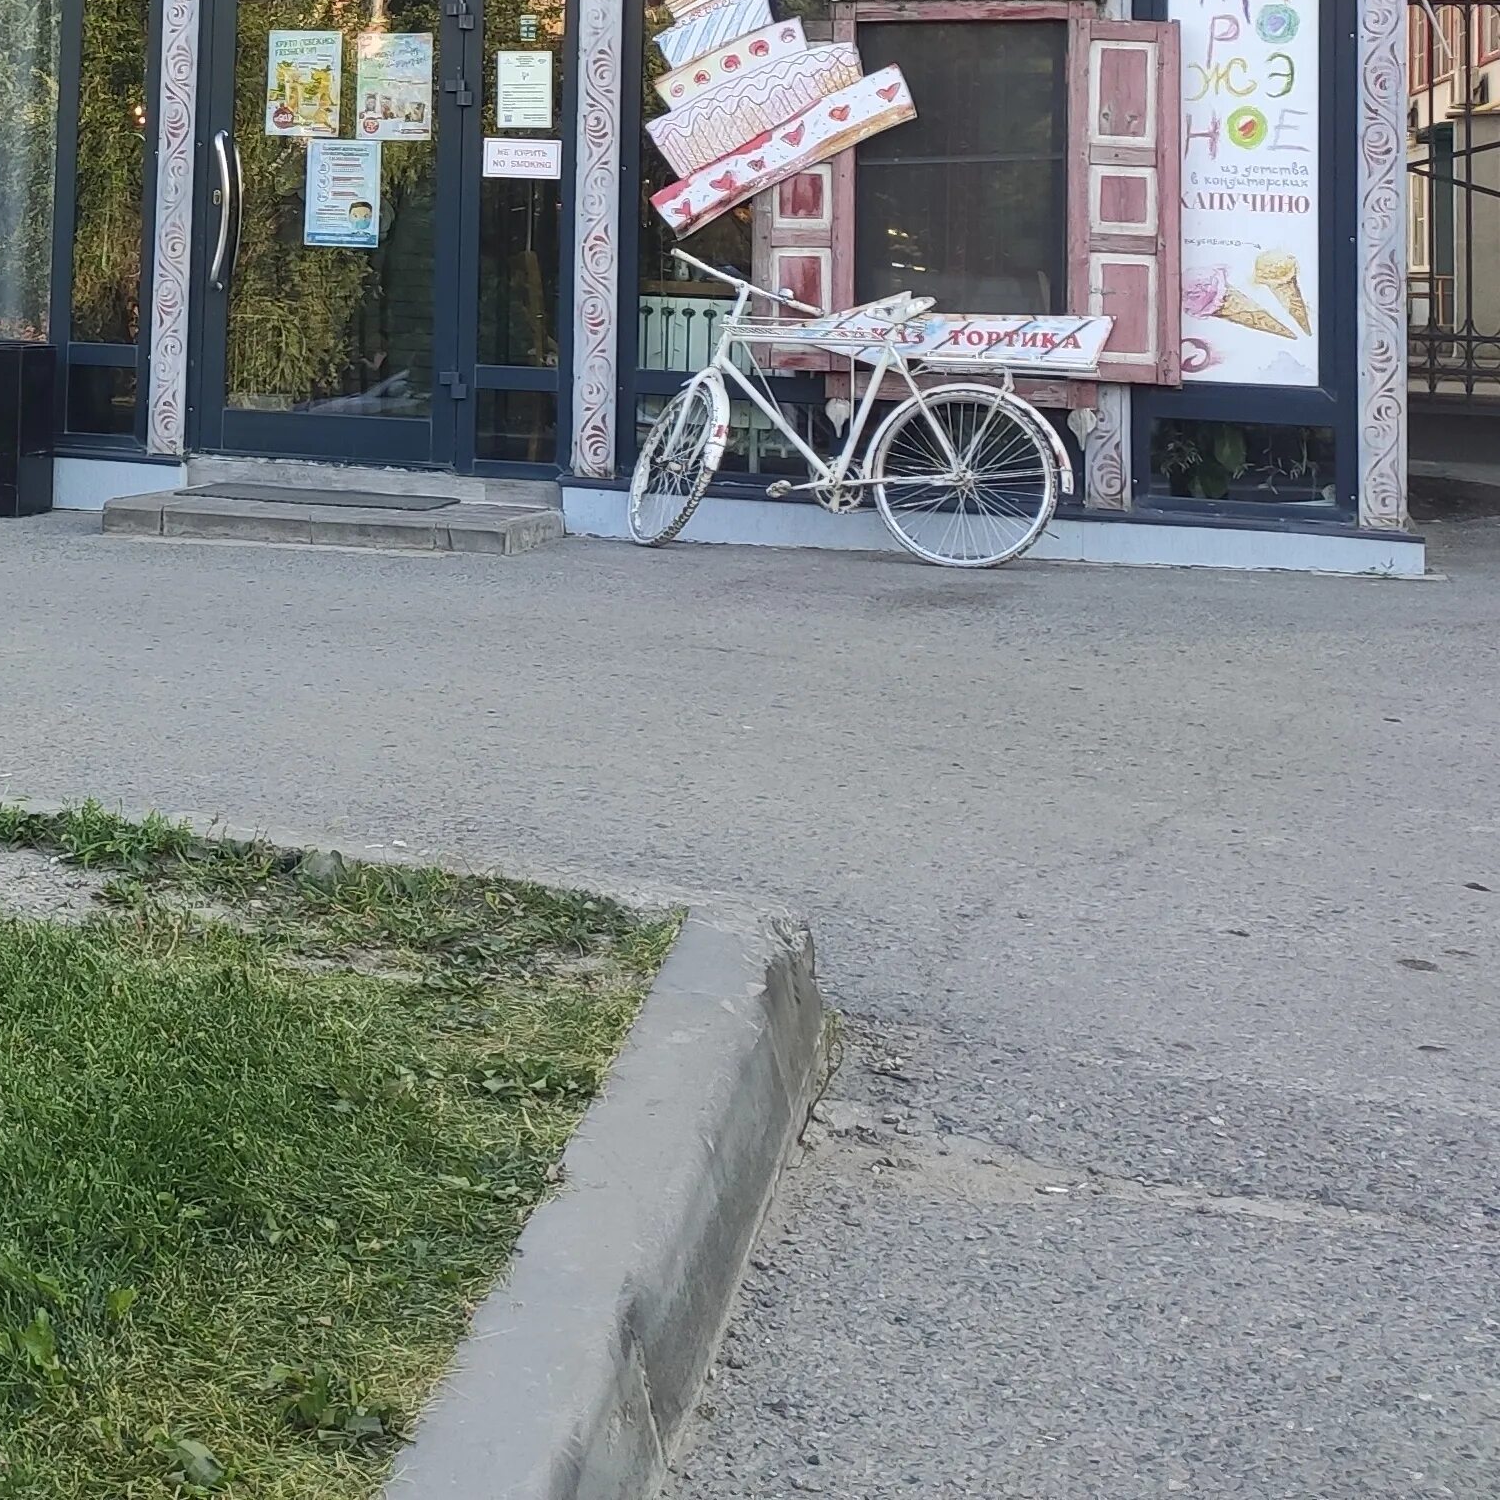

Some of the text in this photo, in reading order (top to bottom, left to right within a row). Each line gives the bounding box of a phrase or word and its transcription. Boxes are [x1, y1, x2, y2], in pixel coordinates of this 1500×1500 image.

[497, 148, 511, 156] НЕ
[492, 159, 552, 169] NO SMOKING
[1220, 161, 1309, 178] из детства
[1190, 171, 1309, 191] в кондитерских
[948, 328, 1082, 350] ТОРТИКА
